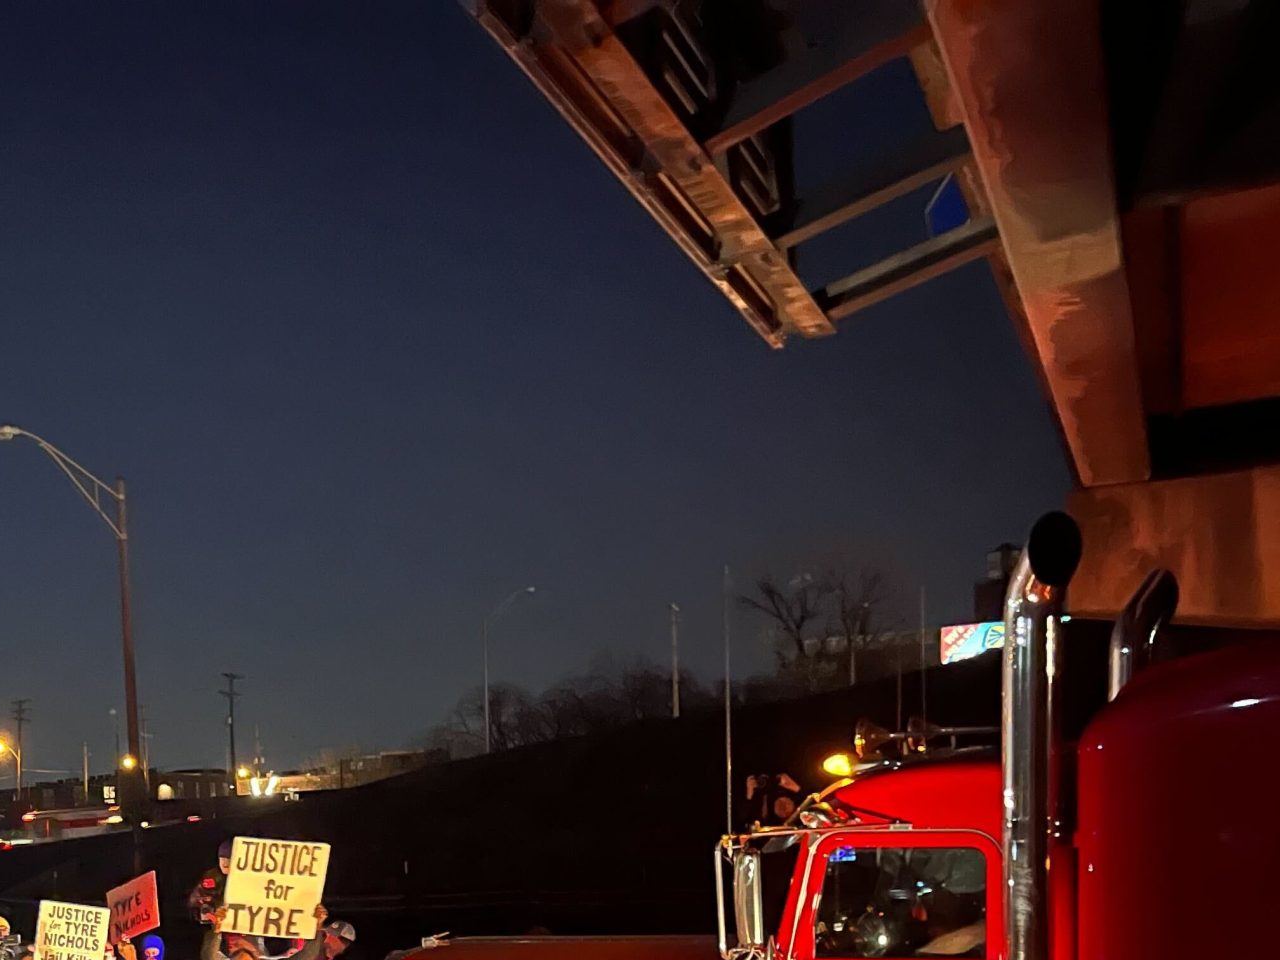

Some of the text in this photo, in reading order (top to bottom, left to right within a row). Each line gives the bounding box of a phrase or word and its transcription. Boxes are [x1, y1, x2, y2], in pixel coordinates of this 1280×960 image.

[237, 841, 322, 876] JUSTICE
[264, 879, 294, 900] for
[48, 906, 102, 924] JUSTICE
[228, 904, 304, 936] TYRE
[65, 921, 97, 937] TYRE
[44, 932, 99, 951] NICHOLS
